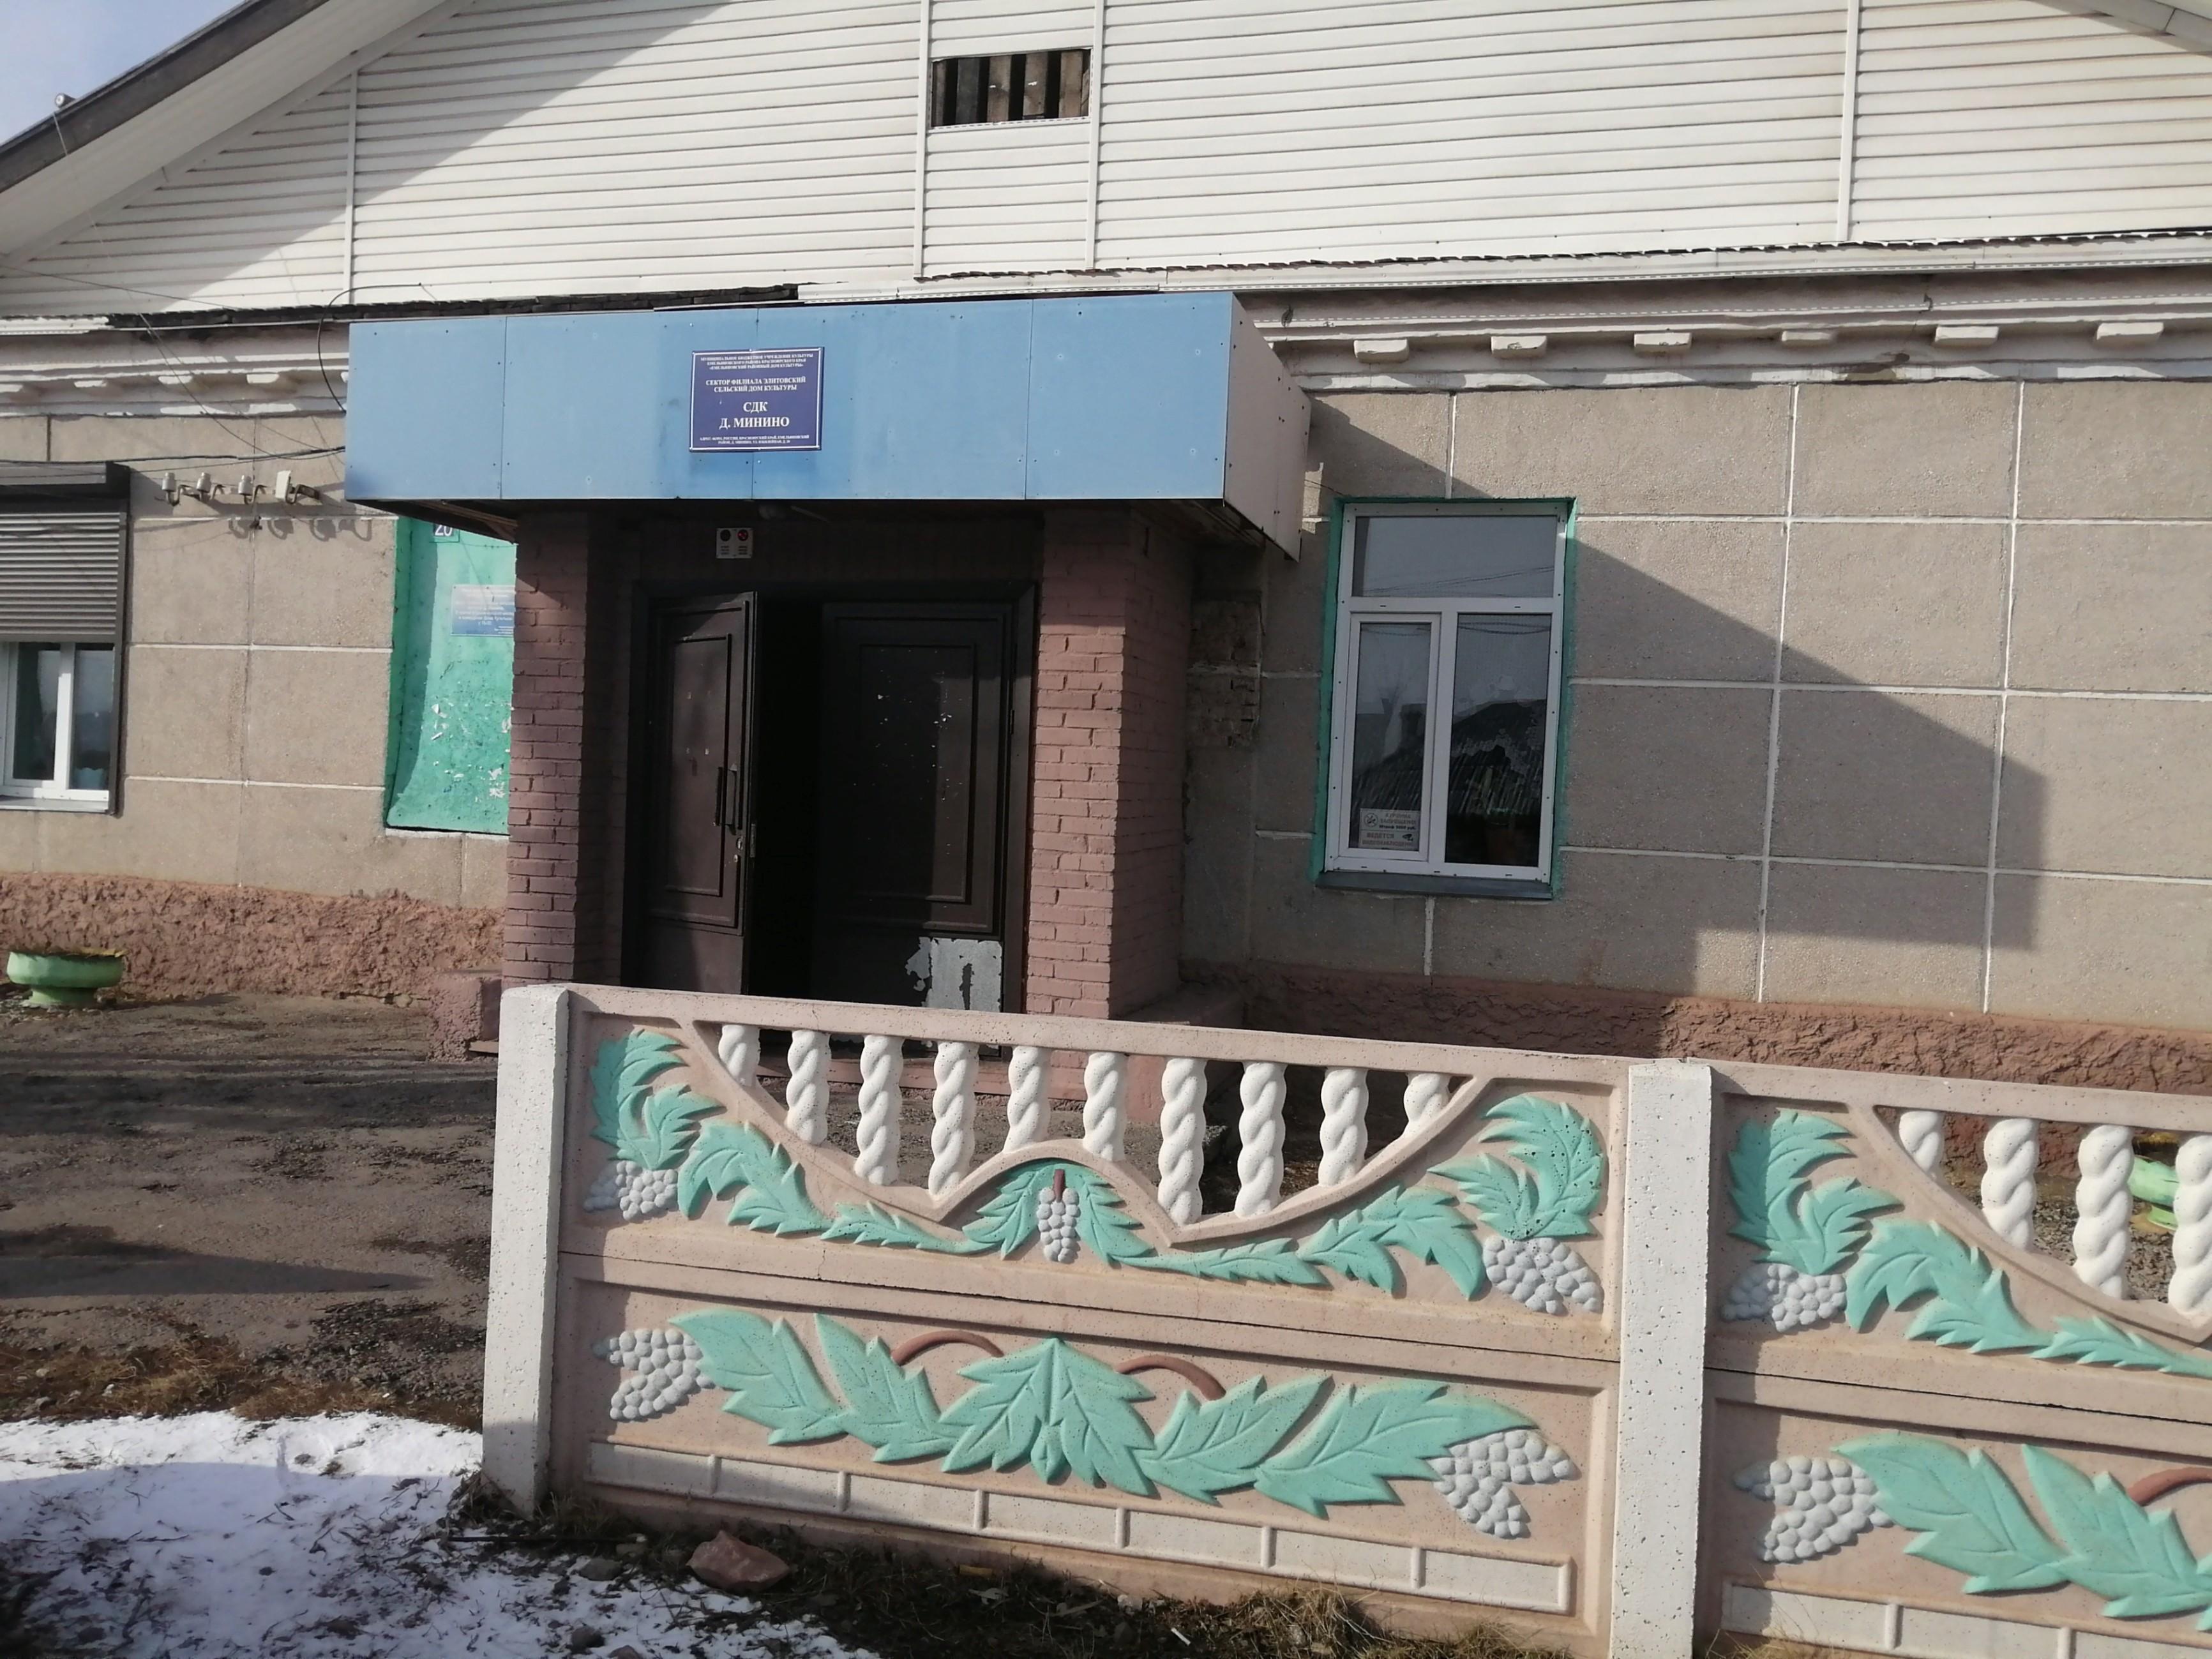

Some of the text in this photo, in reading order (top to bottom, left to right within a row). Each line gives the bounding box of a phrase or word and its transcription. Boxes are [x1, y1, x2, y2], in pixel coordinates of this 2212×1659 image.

[742, 402, 769, 414] СДК
[719, 416, 790, 430] Д. МИНИНО
